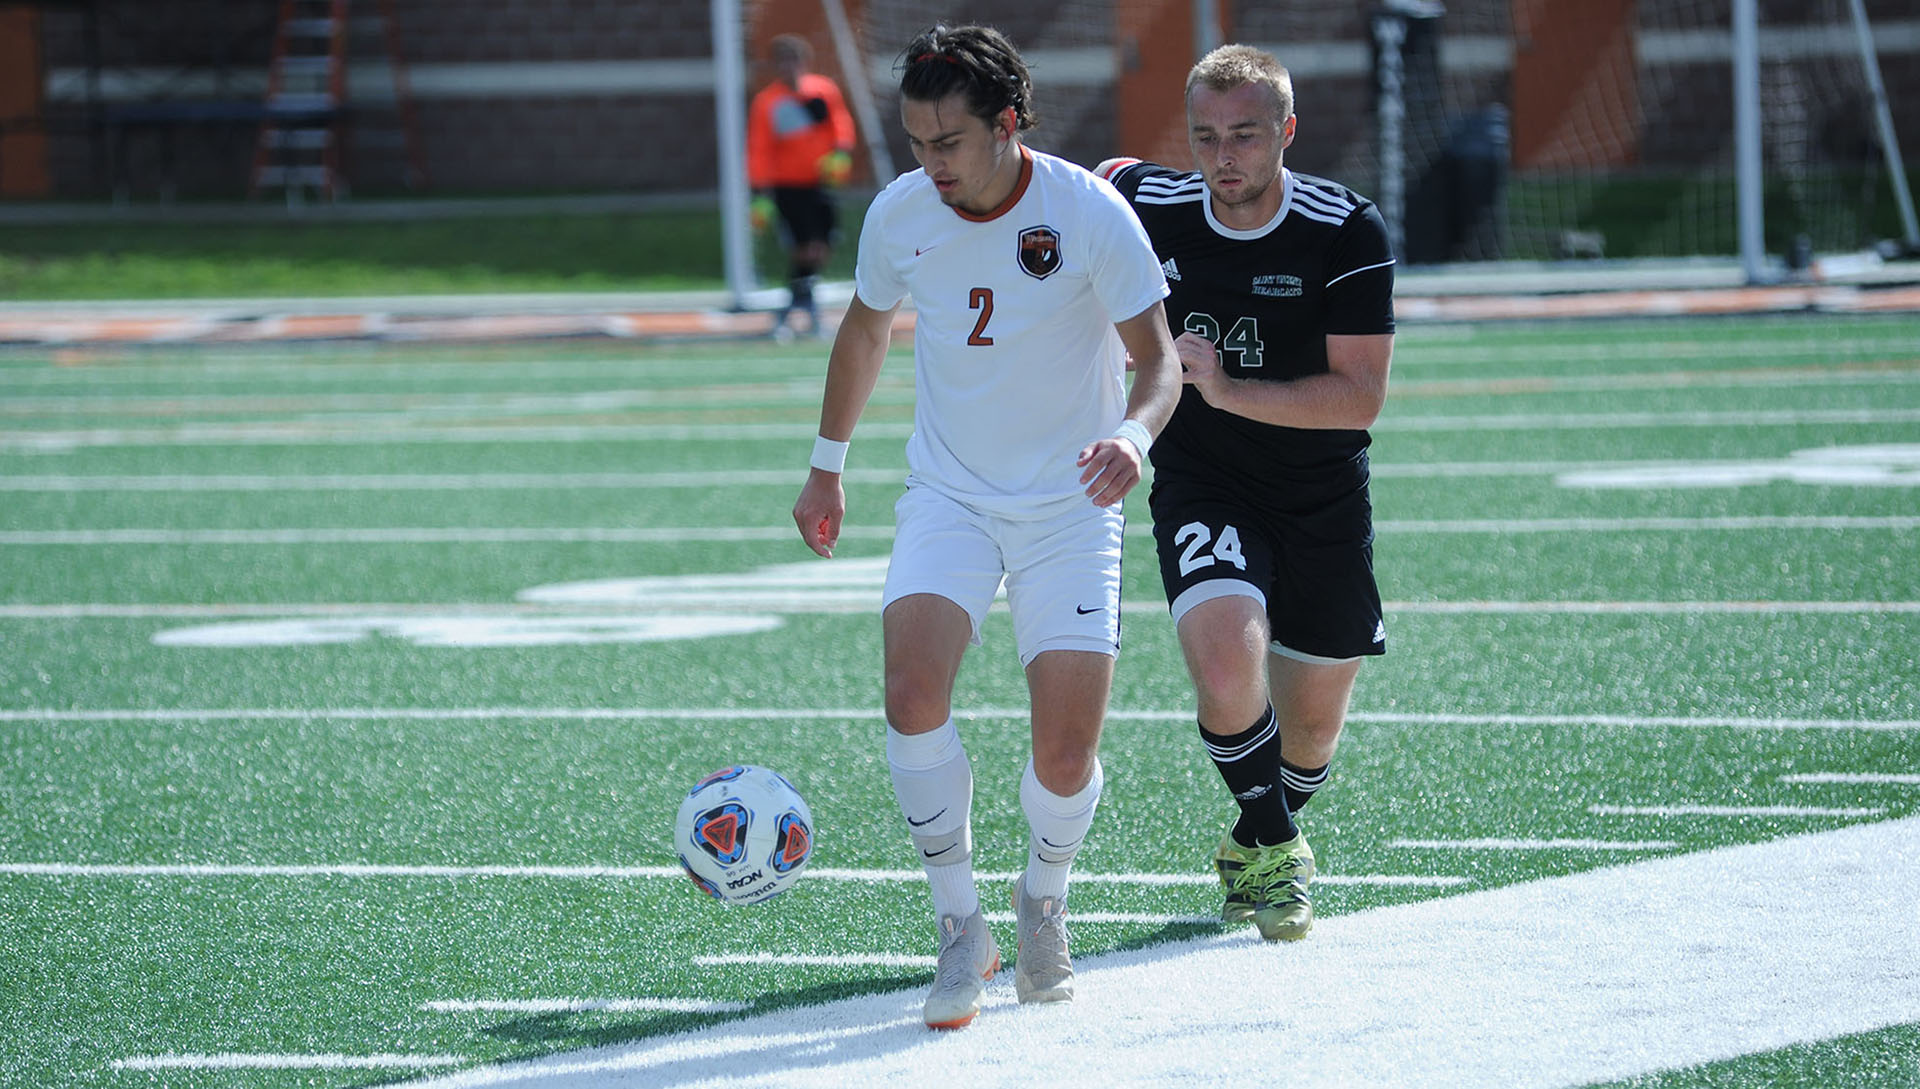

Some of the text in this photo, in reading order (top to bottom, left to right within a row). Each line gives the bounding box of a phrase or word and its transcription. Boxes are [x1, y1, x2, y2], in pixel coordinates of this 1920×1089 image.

[967, 287, 994, 346] 2
[1184, 312, 1264, 367] 24
[1174, 521, 1247, 578] 24
[726, 869, 763, 890] NCAA
